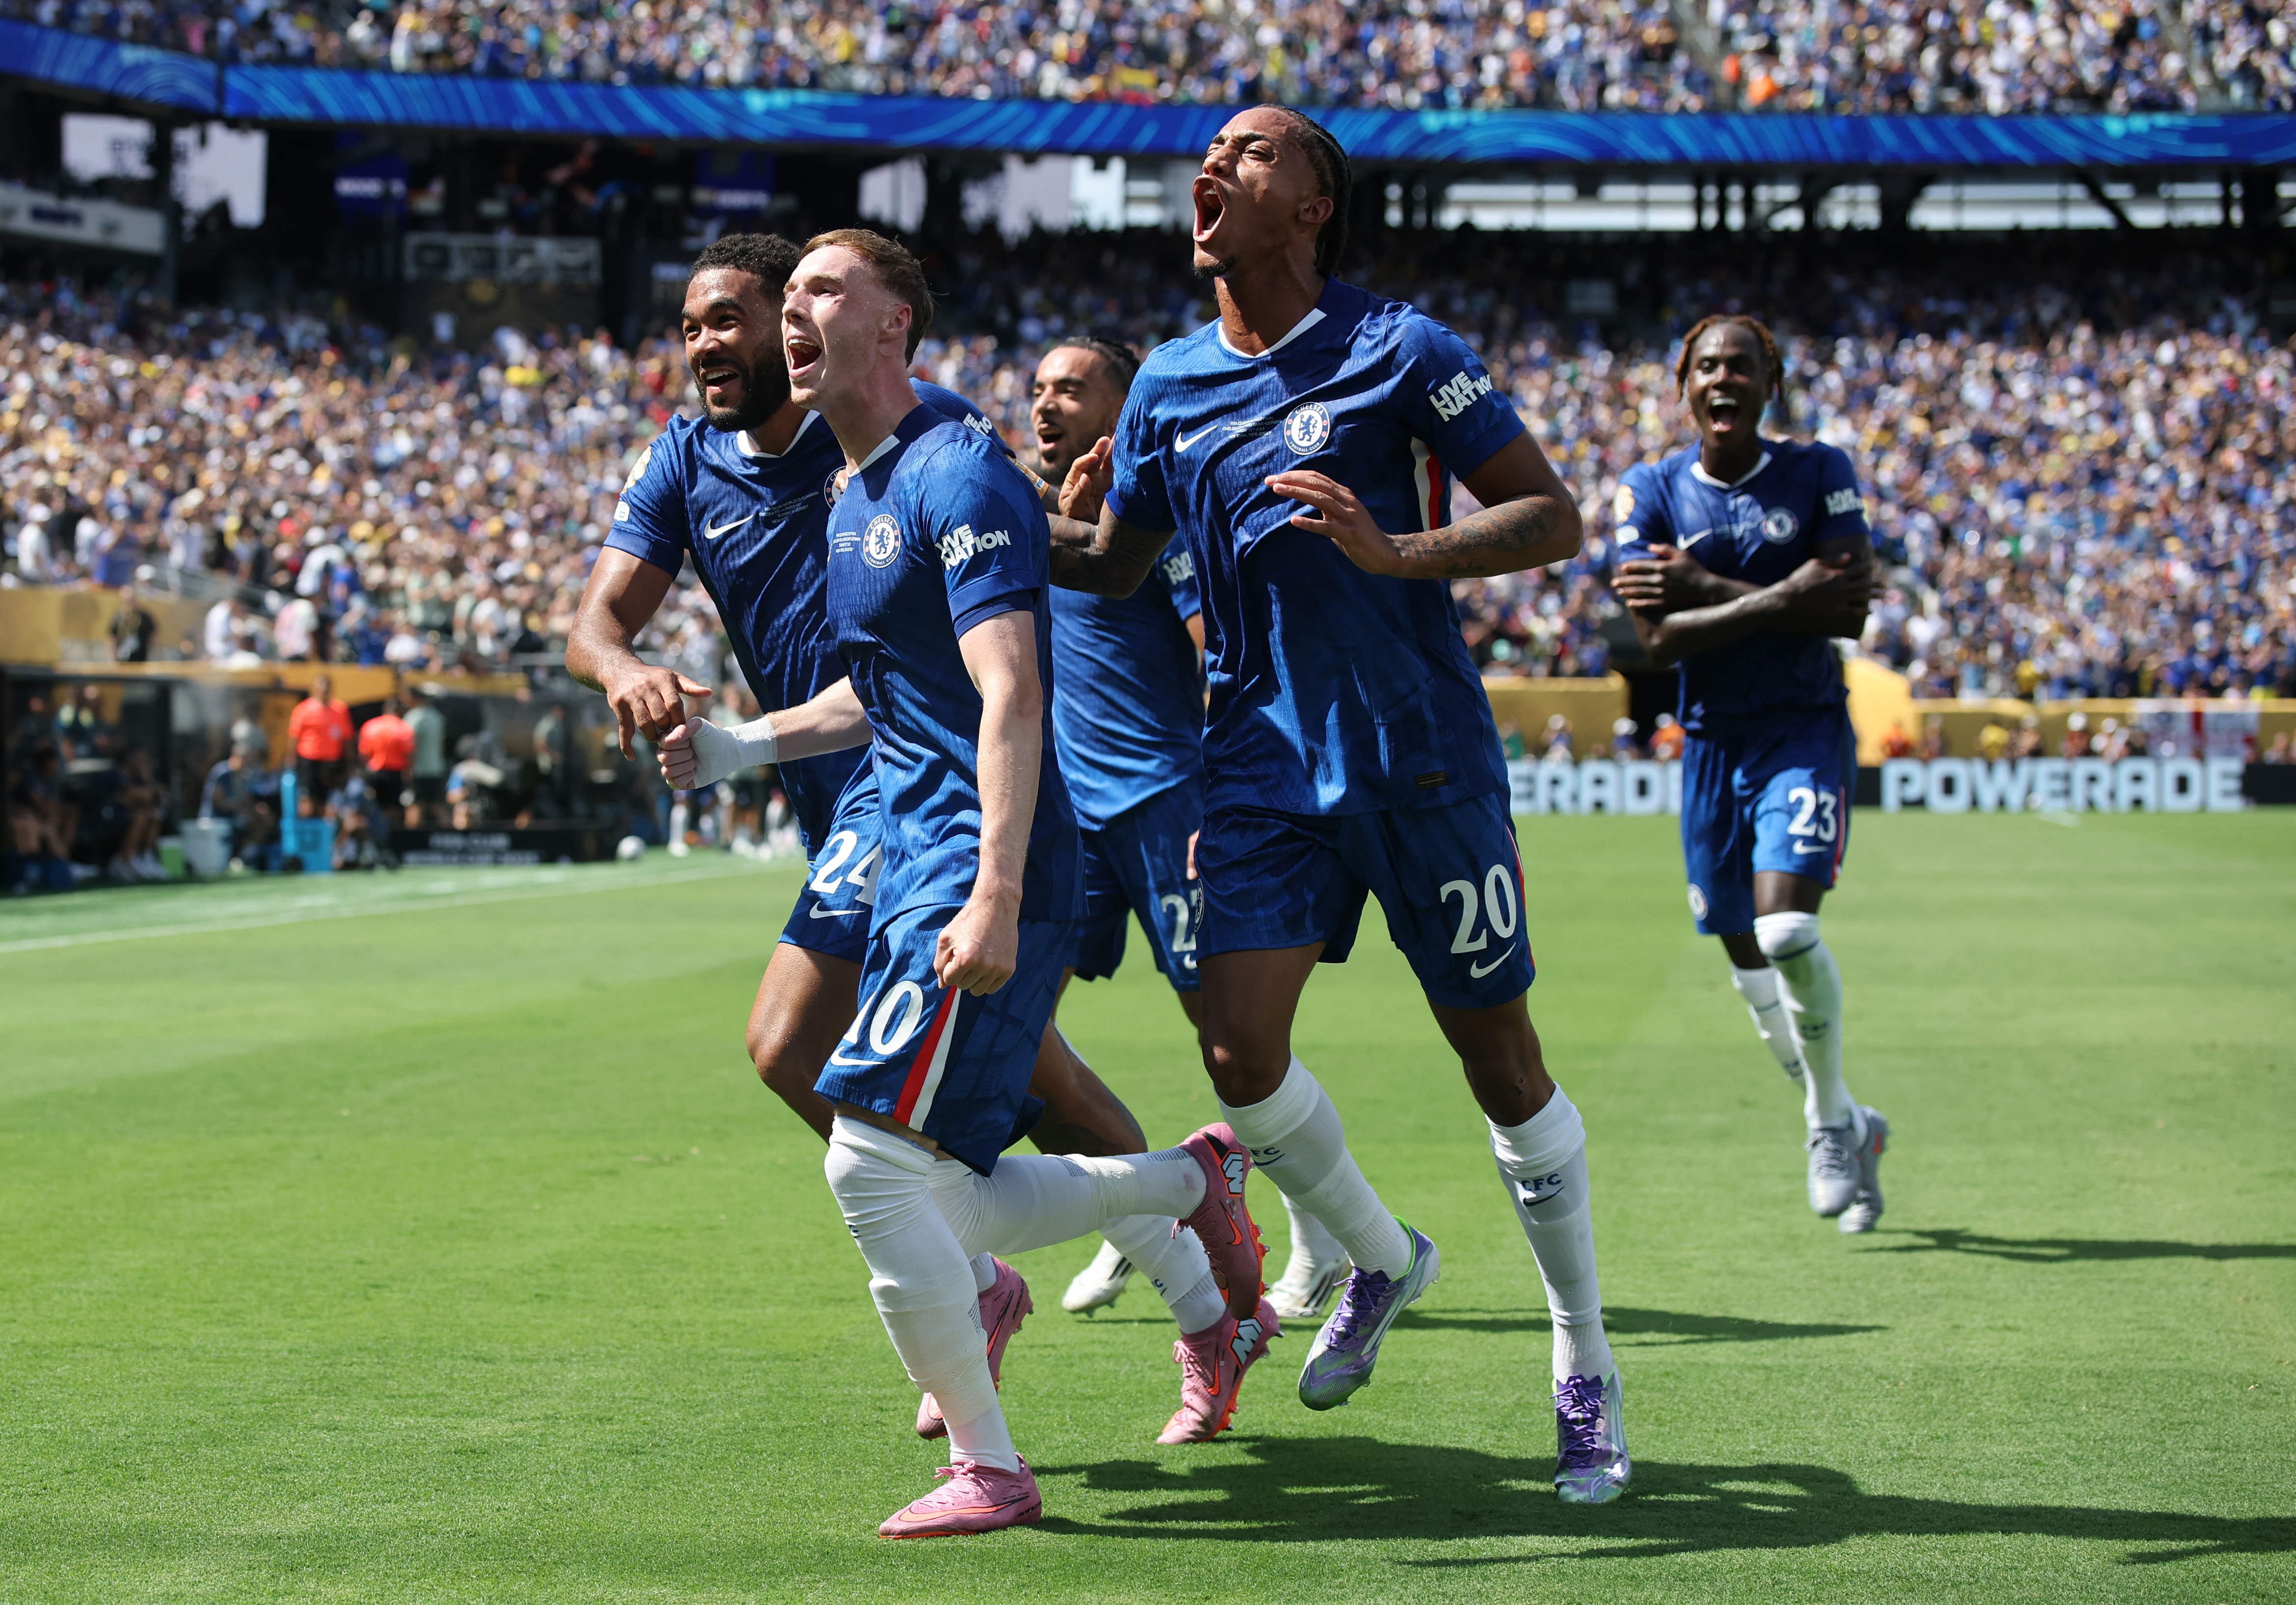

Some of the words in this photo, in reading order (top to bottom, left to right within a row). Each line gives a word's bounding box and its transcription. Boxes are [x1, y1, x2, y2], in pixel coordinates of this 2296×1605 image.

[1295, 404, 1324, 415] CHELSEA
[1429, 371, 1471, 410] LIVE
[1437, 374, 1493, 422] NATION
[1290, 441, 1308, 452] FOOTBALL
[1309, 442, 1320, 450] CLUB
[870, 516, 893, 529] CHELSEA
[869, 556, 885, 565] FOOTBALL
[886, 553, 895, 562] CLUB
[941, 530, 1011, 570] NATION
[1881, 757, 2244, 813] POWERADE
[1787, 786, 1837, 843] 23
[809, 830, 884, 906] 24
[1161, 889, 1197, 953] 2
[1440, 864, 1517, 954] 20
[843, 980, 923, 1055] 10
[1250, 1147, 1281, 1157] FC
[1522, 1173, 1562, 1191] CFC
